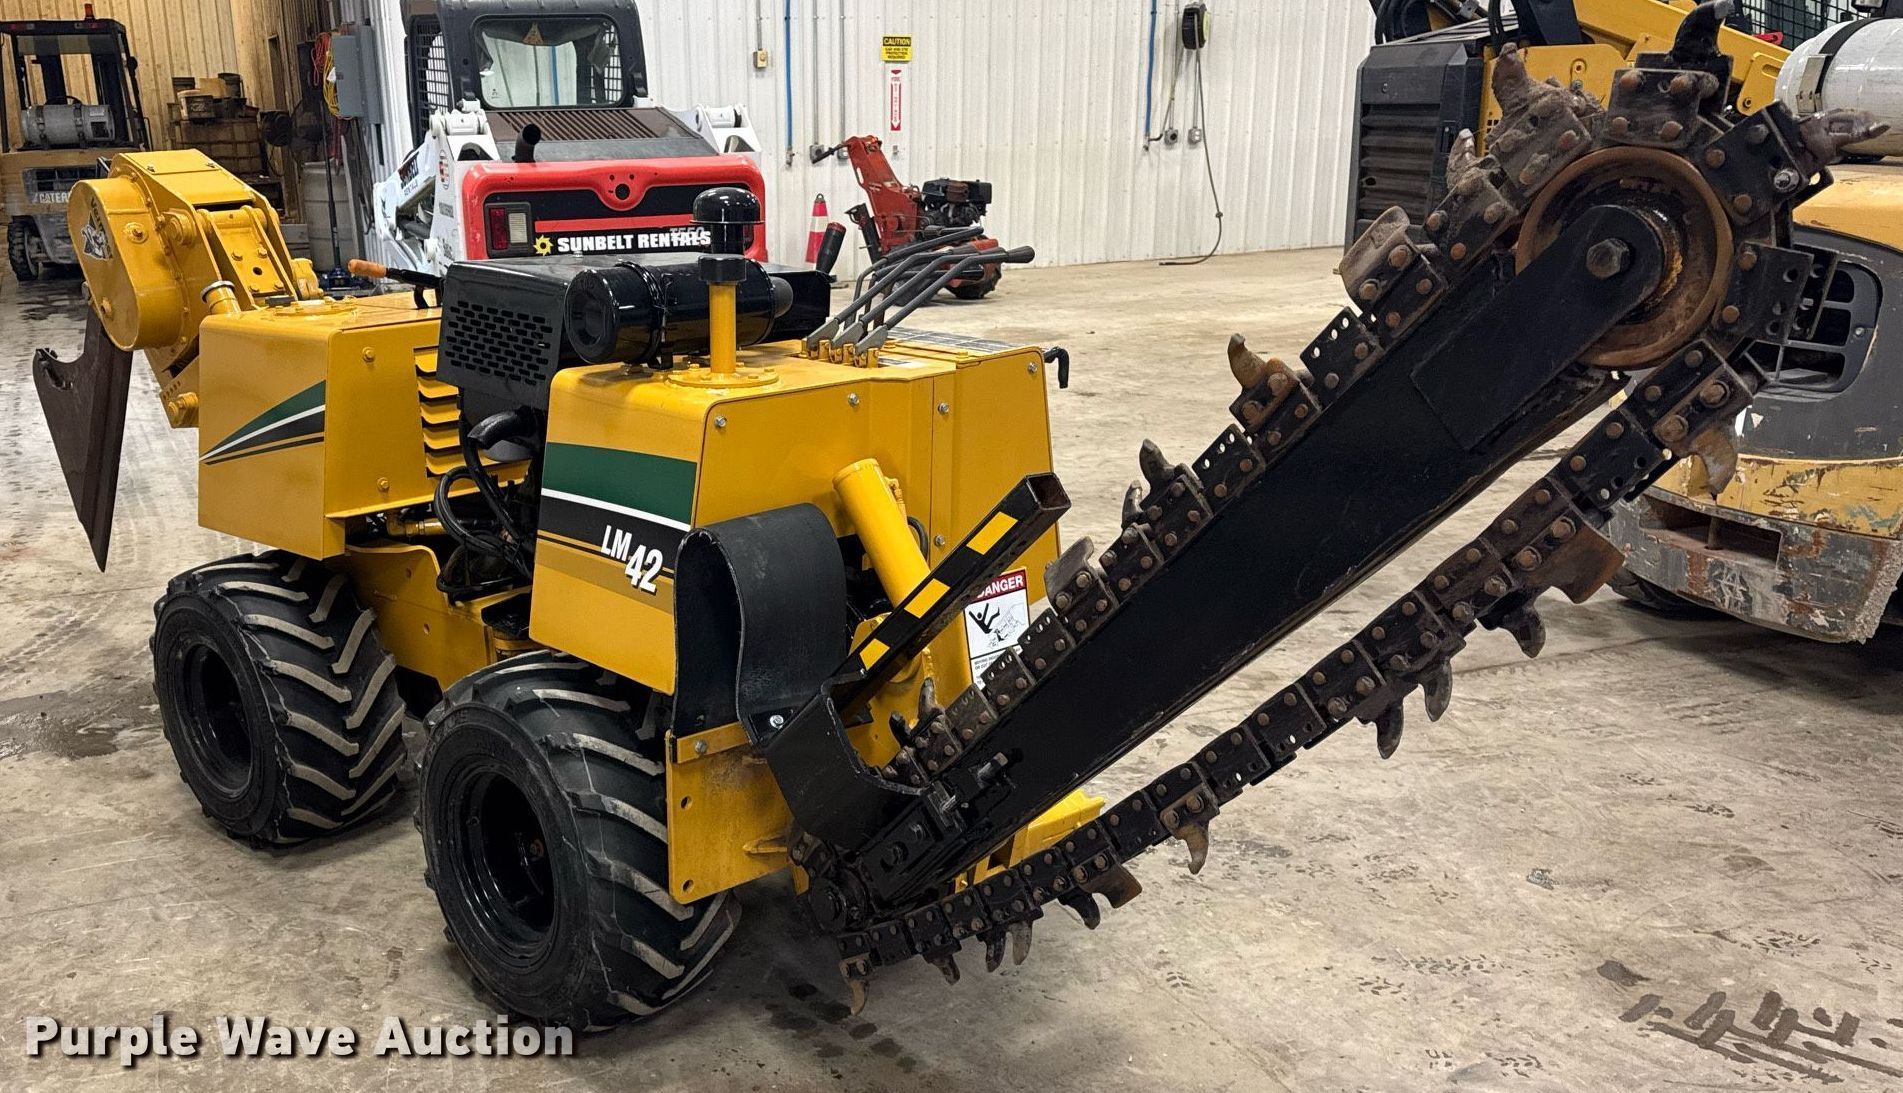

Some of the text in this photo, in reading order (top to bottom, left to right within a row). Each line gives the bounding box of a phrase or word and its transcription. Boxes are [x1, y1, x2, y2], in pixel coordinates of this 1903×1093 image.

[39, 191, 68, 204] CATER
[557, 231, 711, 252] SUNBELT RENTALS
[601, 524, 664, 595] LM 42
[977, 574, 1024, 599] ANGER
